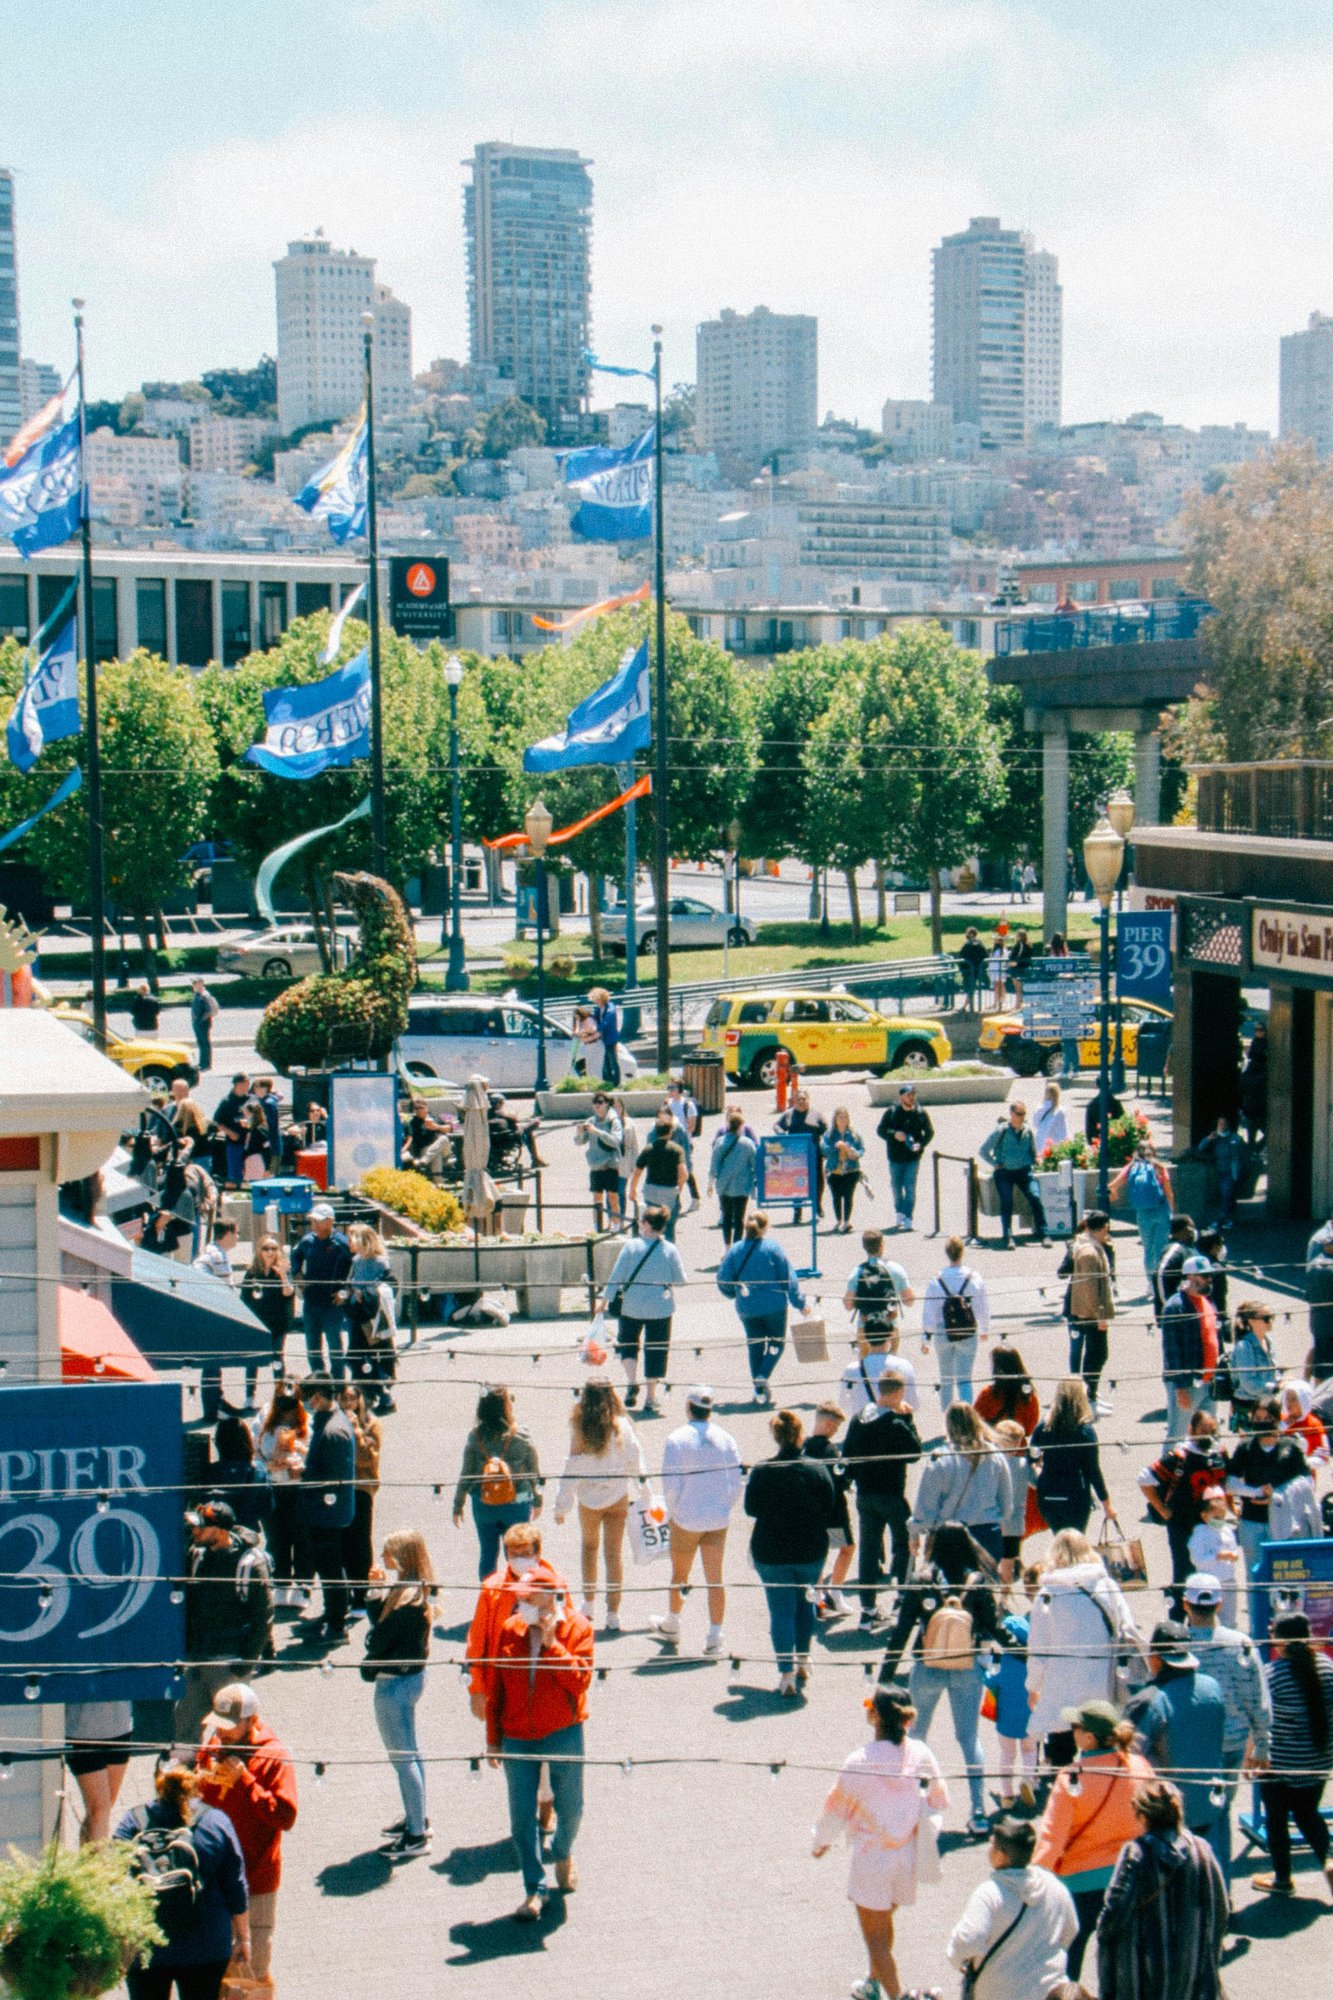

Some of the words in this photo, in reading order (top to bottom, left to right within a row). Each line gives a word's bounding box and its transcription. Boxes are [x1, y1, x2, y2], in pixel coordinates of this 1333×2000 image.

[1123, 926, 1164, 943] PIER
[1259, 918, 1285, 963] Only
[1286, 922, 1299, 956] in
[1300, 924, 1322, 960] San
[1120, 943, 1167, 981] 39
[0, 1445, 163, 1503] PIER
[0, 1508, 161, 1642] 39
